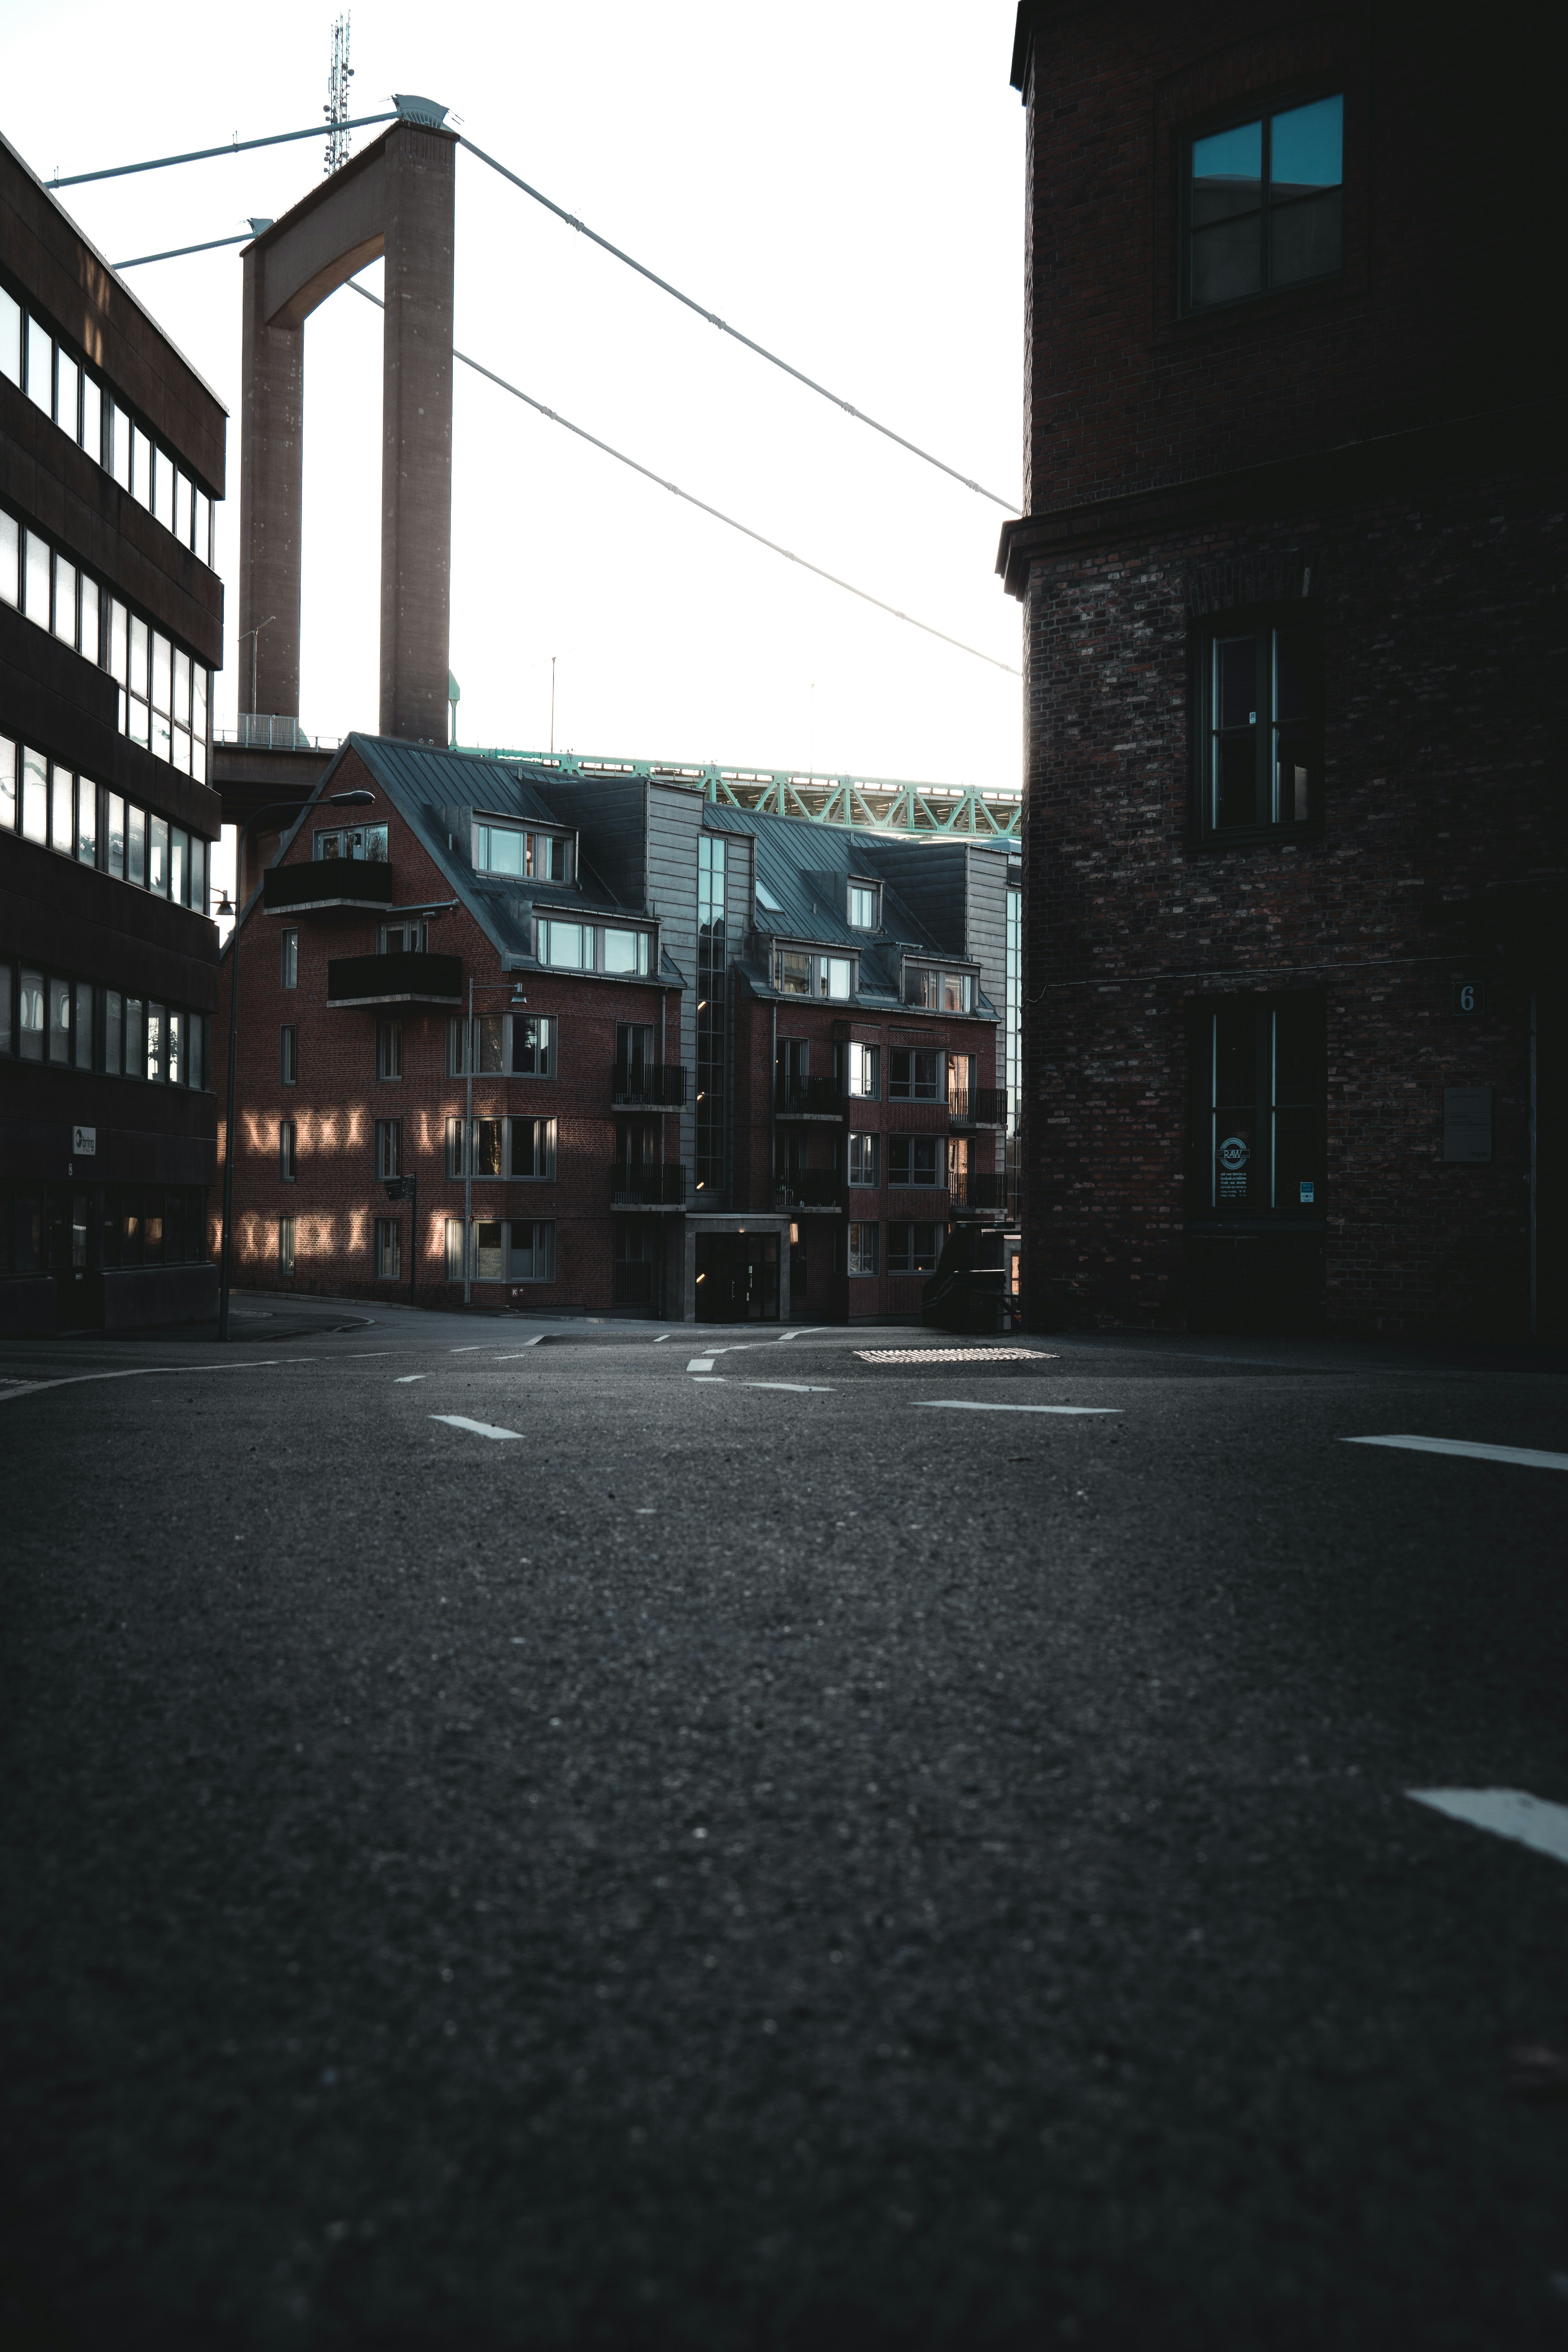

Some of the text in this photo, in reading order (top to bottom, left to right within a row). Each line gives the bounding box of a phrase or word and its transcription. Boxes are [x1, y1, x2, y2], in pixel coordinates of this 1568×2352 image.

[1461, 985, 1474, 1011] 6
[82, 1136, 94, 1152] bring
[1224, 1150, 1241, 1158] RAW
[69, 1163, 73, 1176] 8
